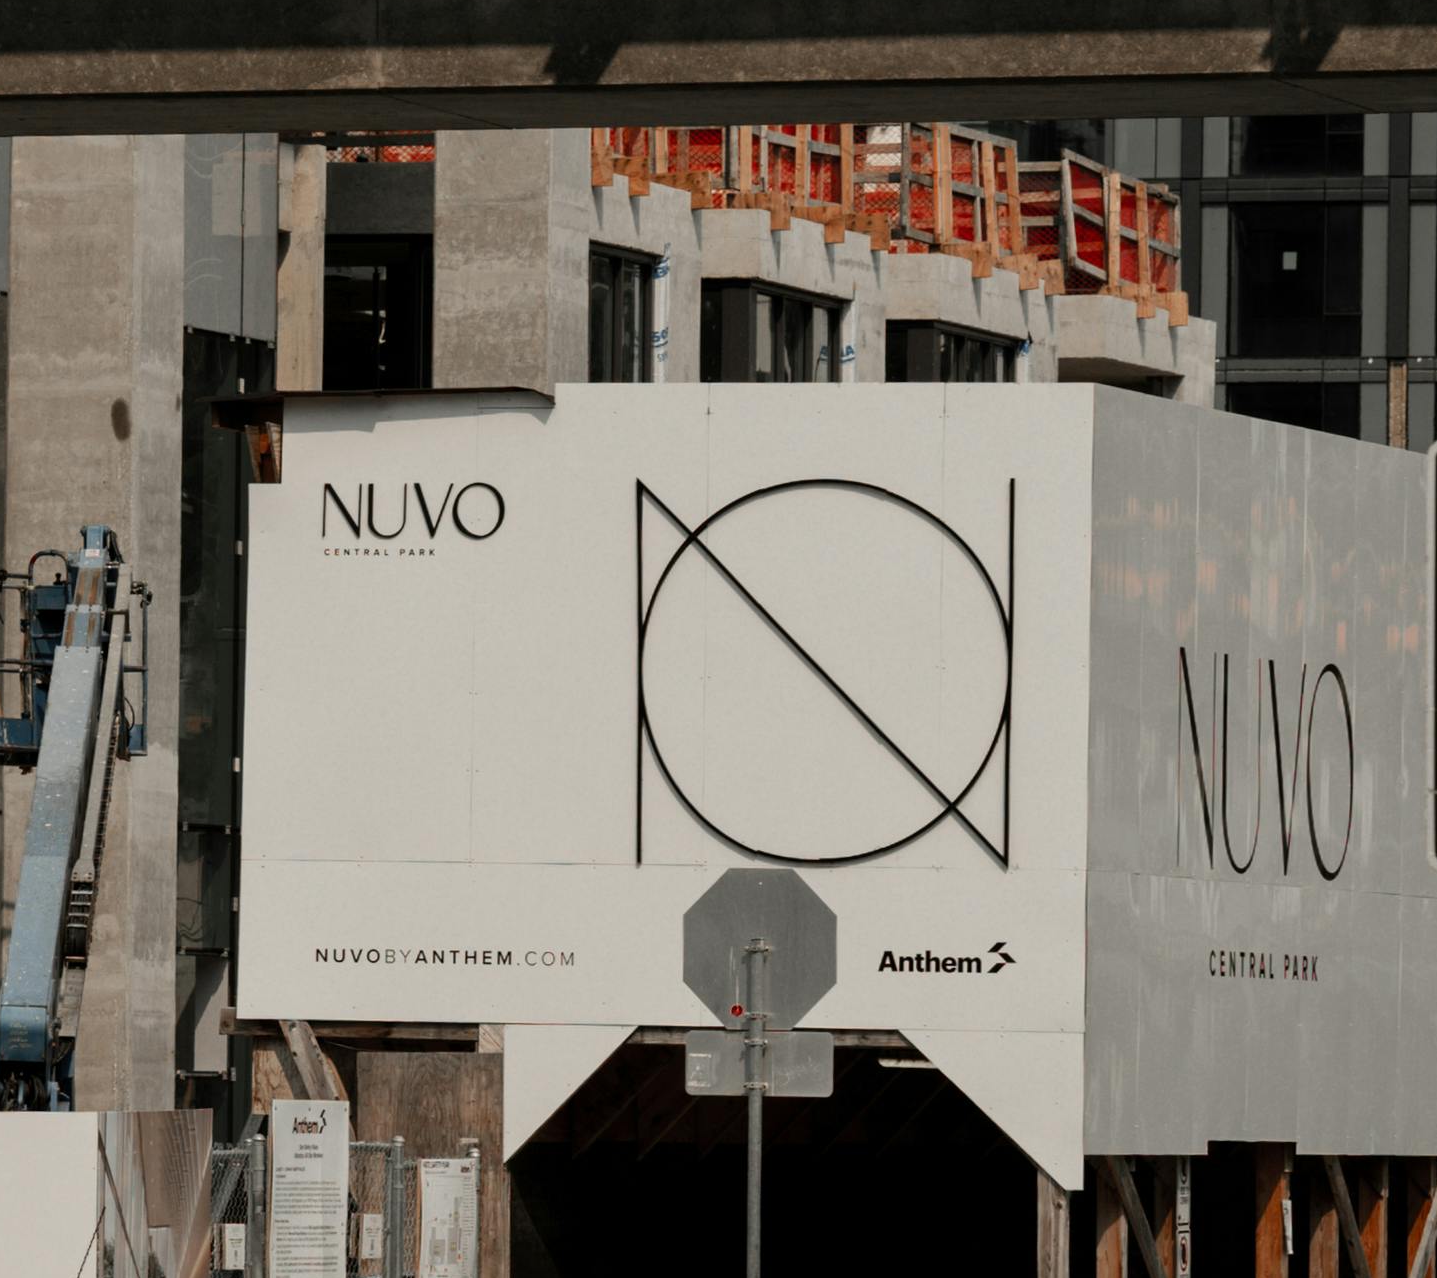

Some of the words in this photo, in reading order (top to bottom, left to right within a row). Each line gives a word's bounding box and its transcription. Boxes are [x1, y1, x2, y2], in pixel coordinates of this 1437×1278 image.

[321, 482, 506, 541] NUVO
[323, 548, 389, 557] CENTRAL
[399, 548, 436, 556] PARK
[1178, 647, 1354, 882] NUVO
[315, 948, 576, 967] NUVOBYANTHEM.COM
[878, 950, 983, 975] Anthem
[1209, 951, 1274, 980] CENTRAL
[1284, 955, 1318, 982] PARK
